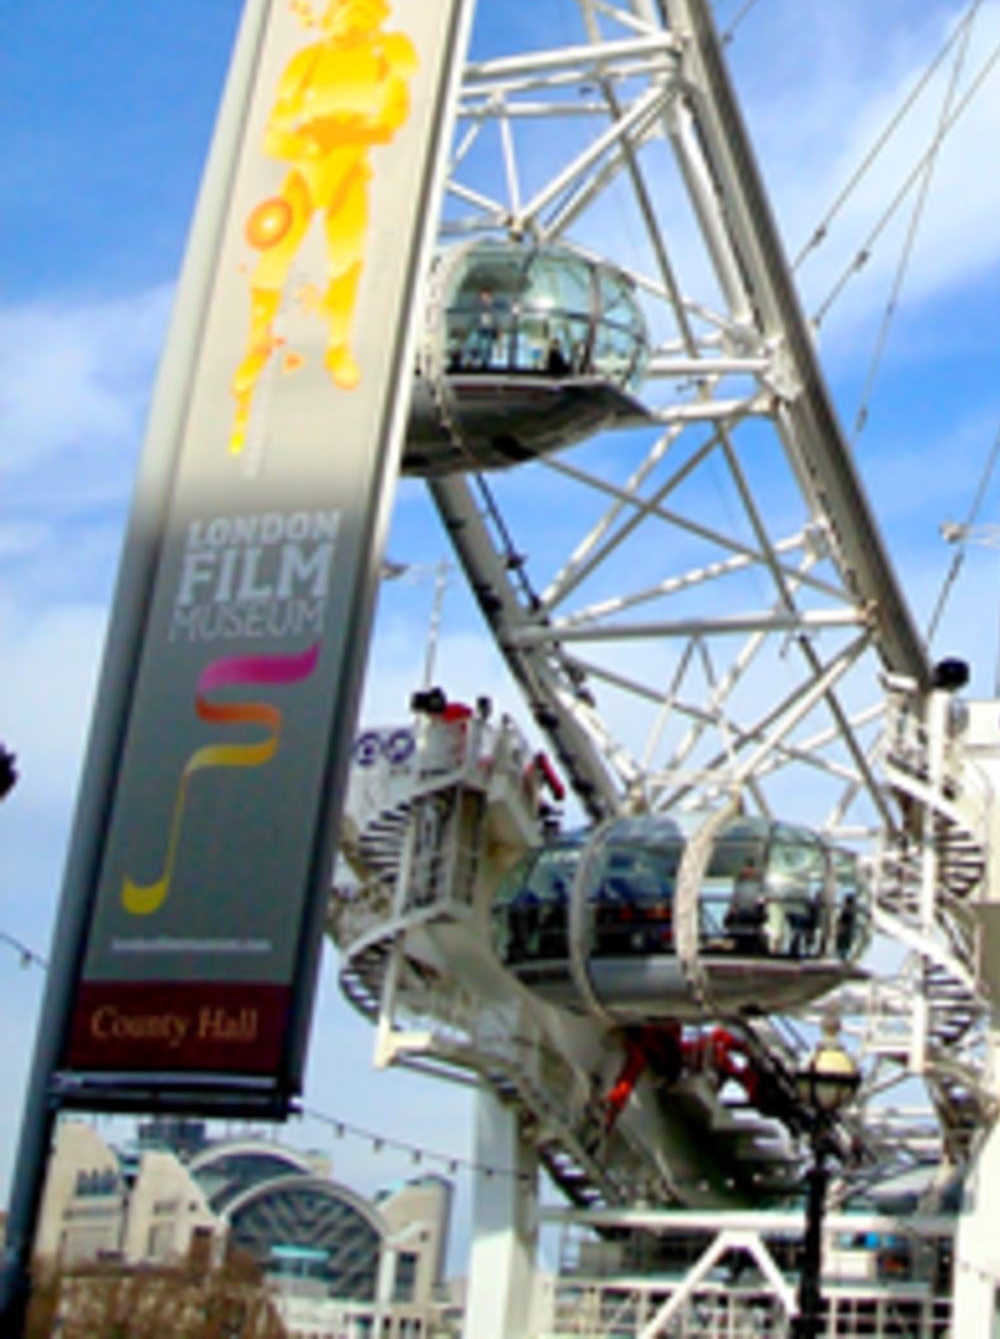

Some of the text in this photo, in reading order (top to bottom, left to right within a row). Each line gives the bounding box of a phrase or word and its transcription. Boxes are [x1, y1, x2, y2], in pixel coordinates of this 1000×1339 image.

[188, 510, 341, 549] LONDON
[176, 543, 335, 606] FILM
[169, 600, 324, 642] MUSEUM
[90, 1004, 259, 1048] County Hall
